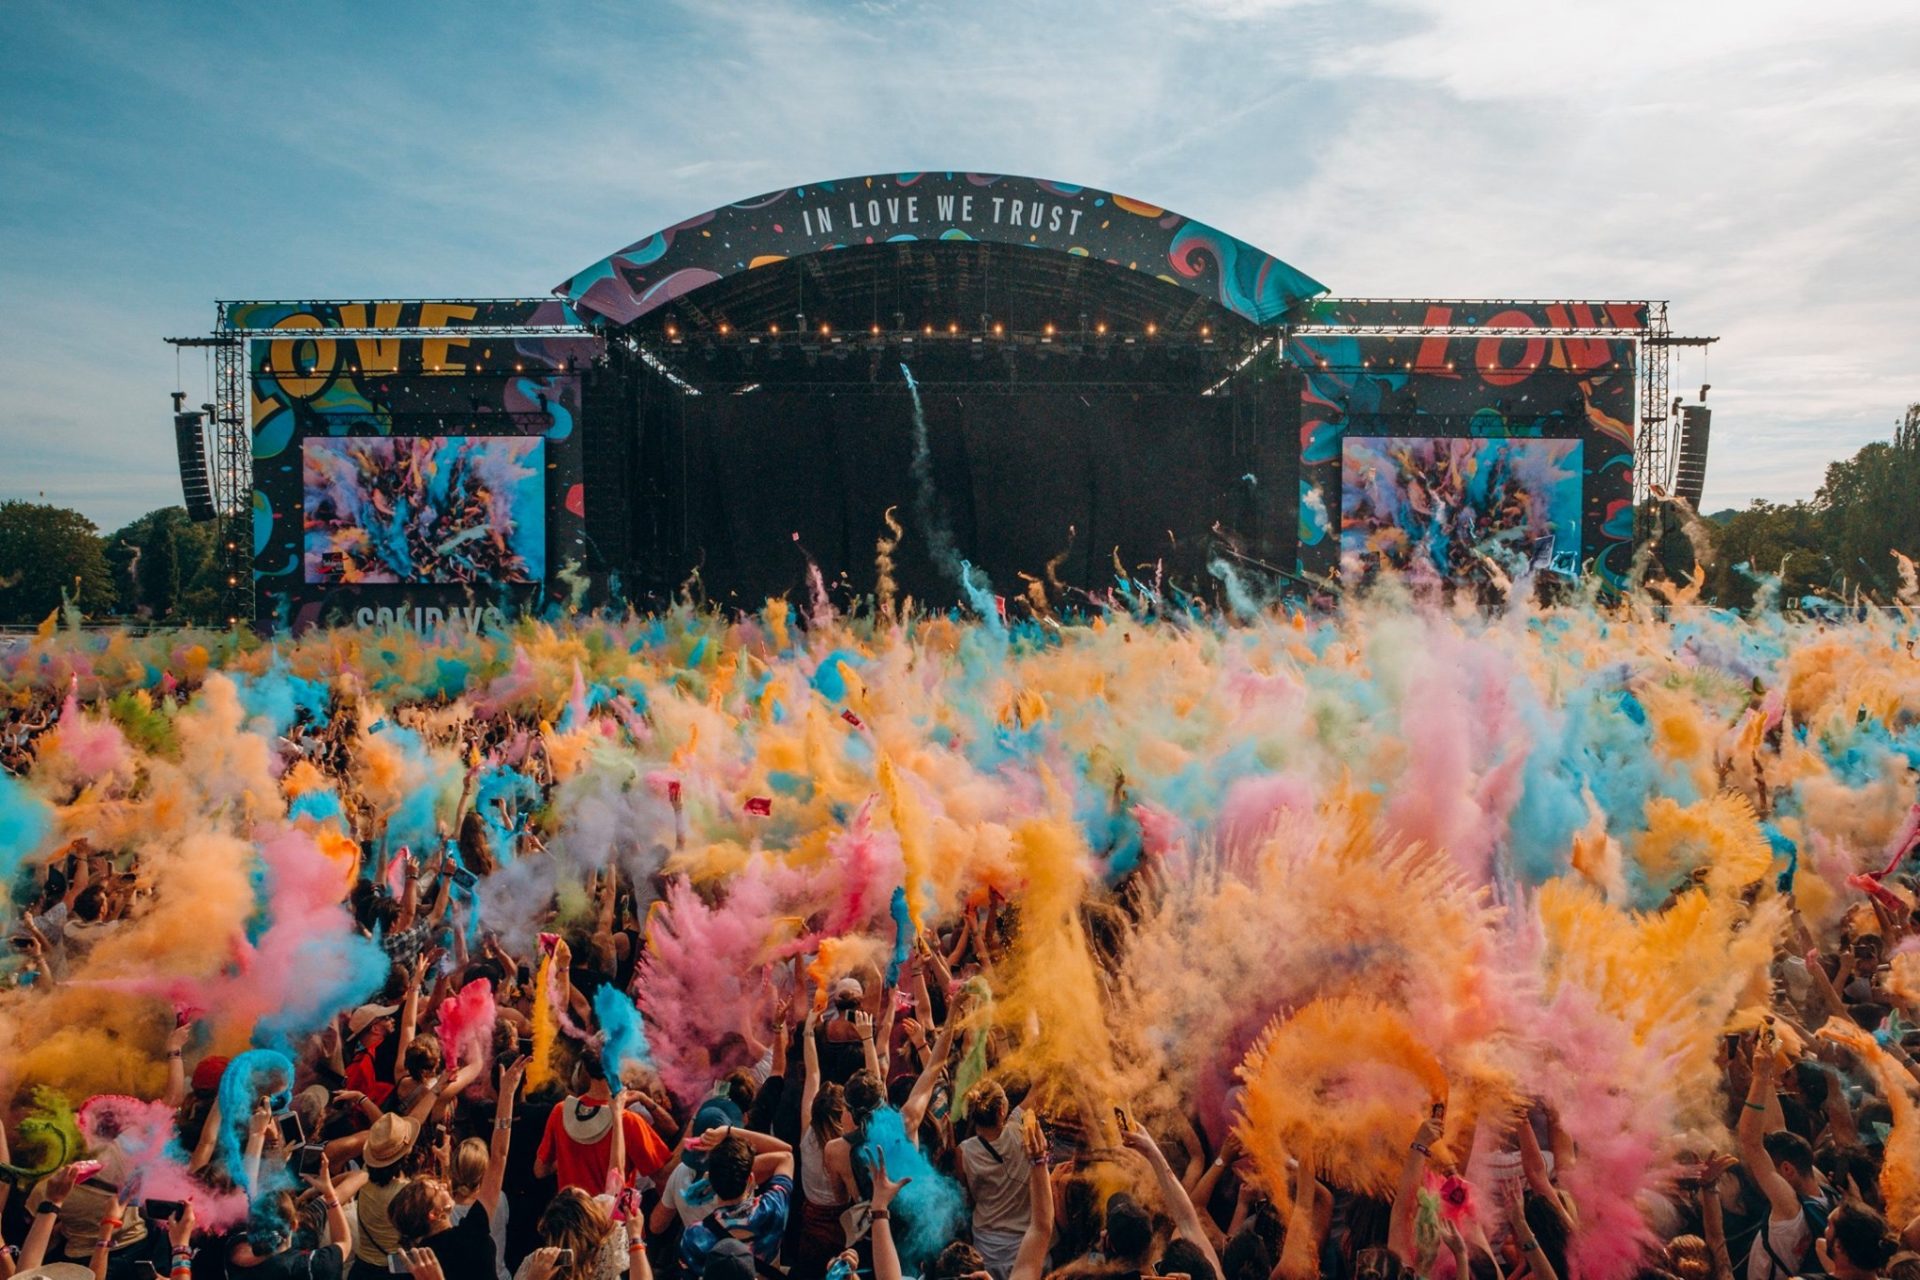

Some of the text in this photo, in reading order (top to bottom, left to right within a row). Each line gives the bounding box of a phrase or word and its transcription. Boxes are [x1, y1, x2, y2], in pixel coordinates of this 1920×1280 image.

[802, 195, 1082, 237] IN LOVE WE TRUST
[356, 606, 502, 637] SOIDYS
